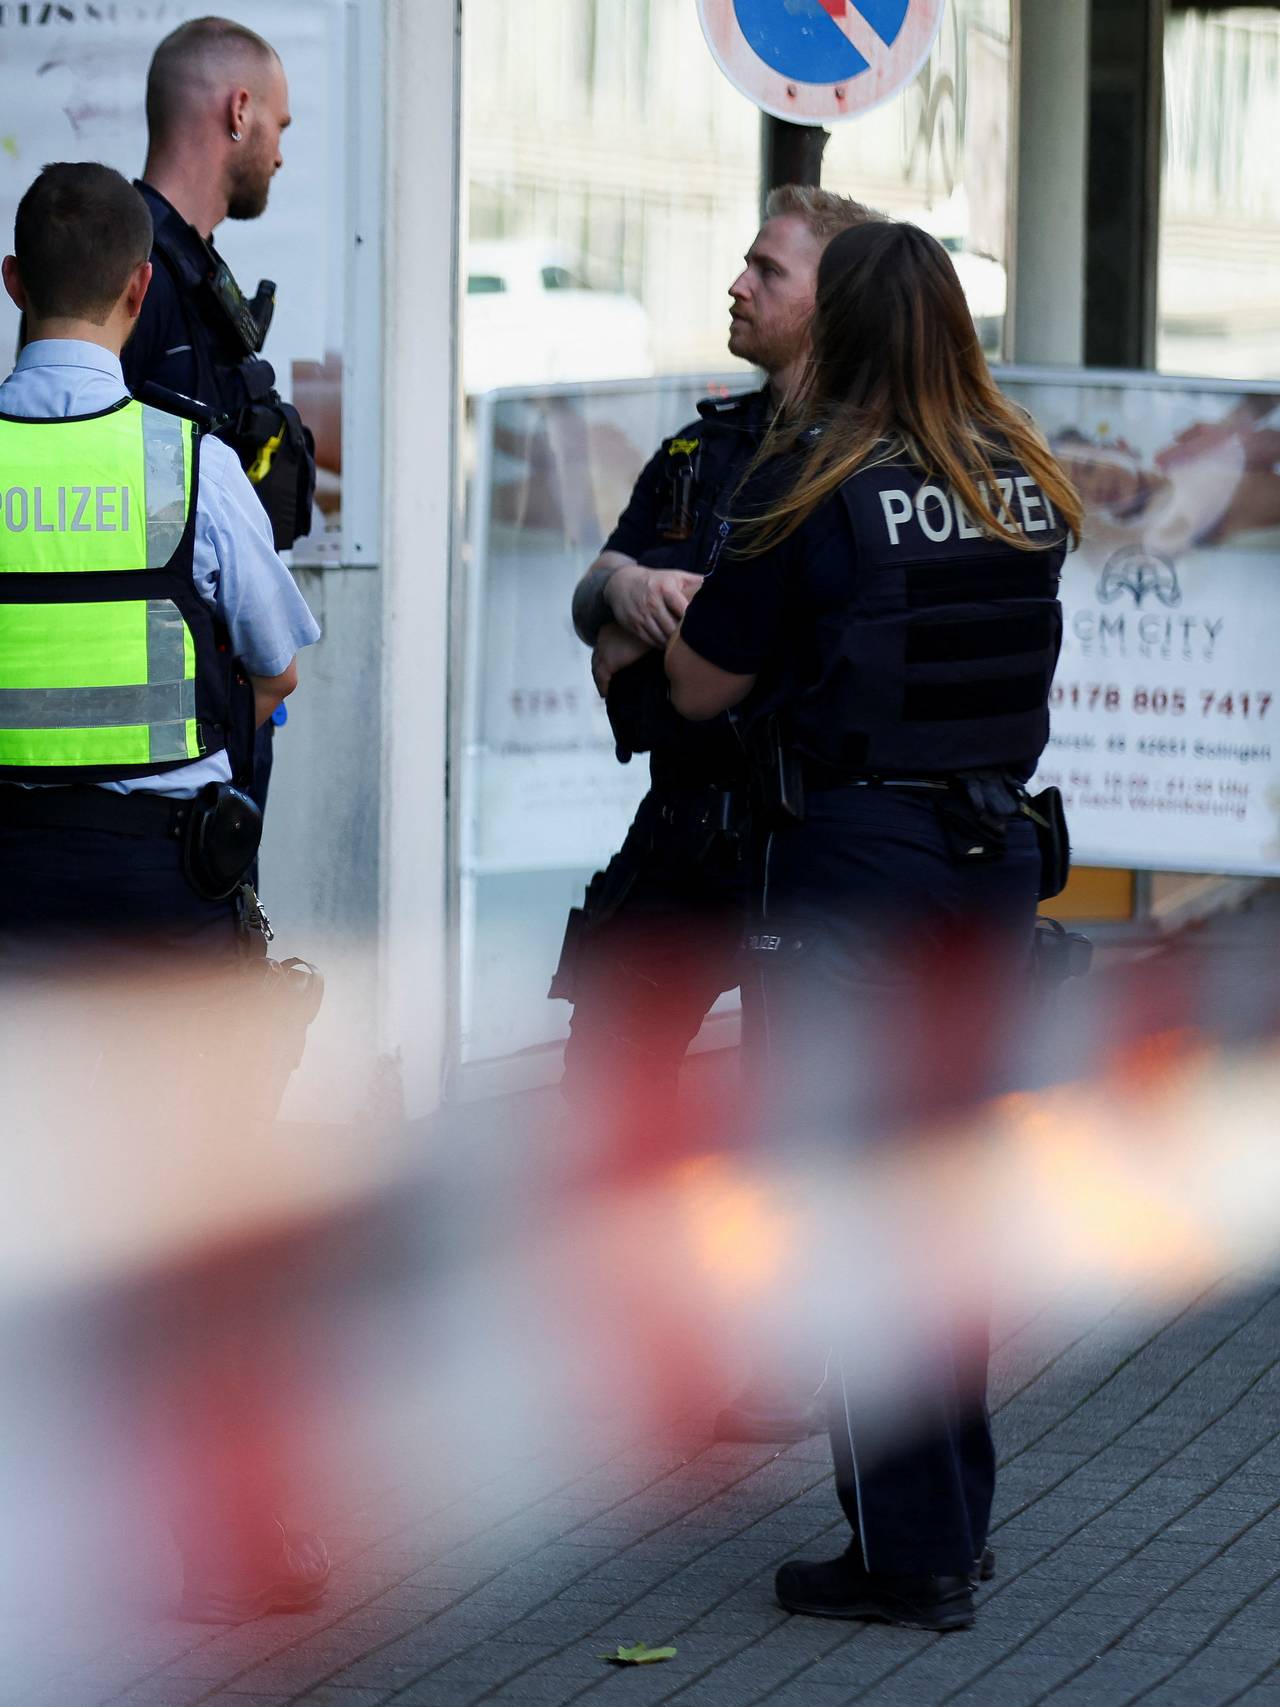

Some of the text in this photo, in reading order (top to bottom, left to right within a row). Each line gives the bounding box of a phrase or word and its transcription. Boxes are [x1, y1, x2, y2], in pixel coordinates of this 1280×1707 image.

[878, 476, 1056, 545] POLIZEI
[1065, 608, 1224, 646] CM CITY
[1049, 681, 1272, 720] 0178 805 7417
